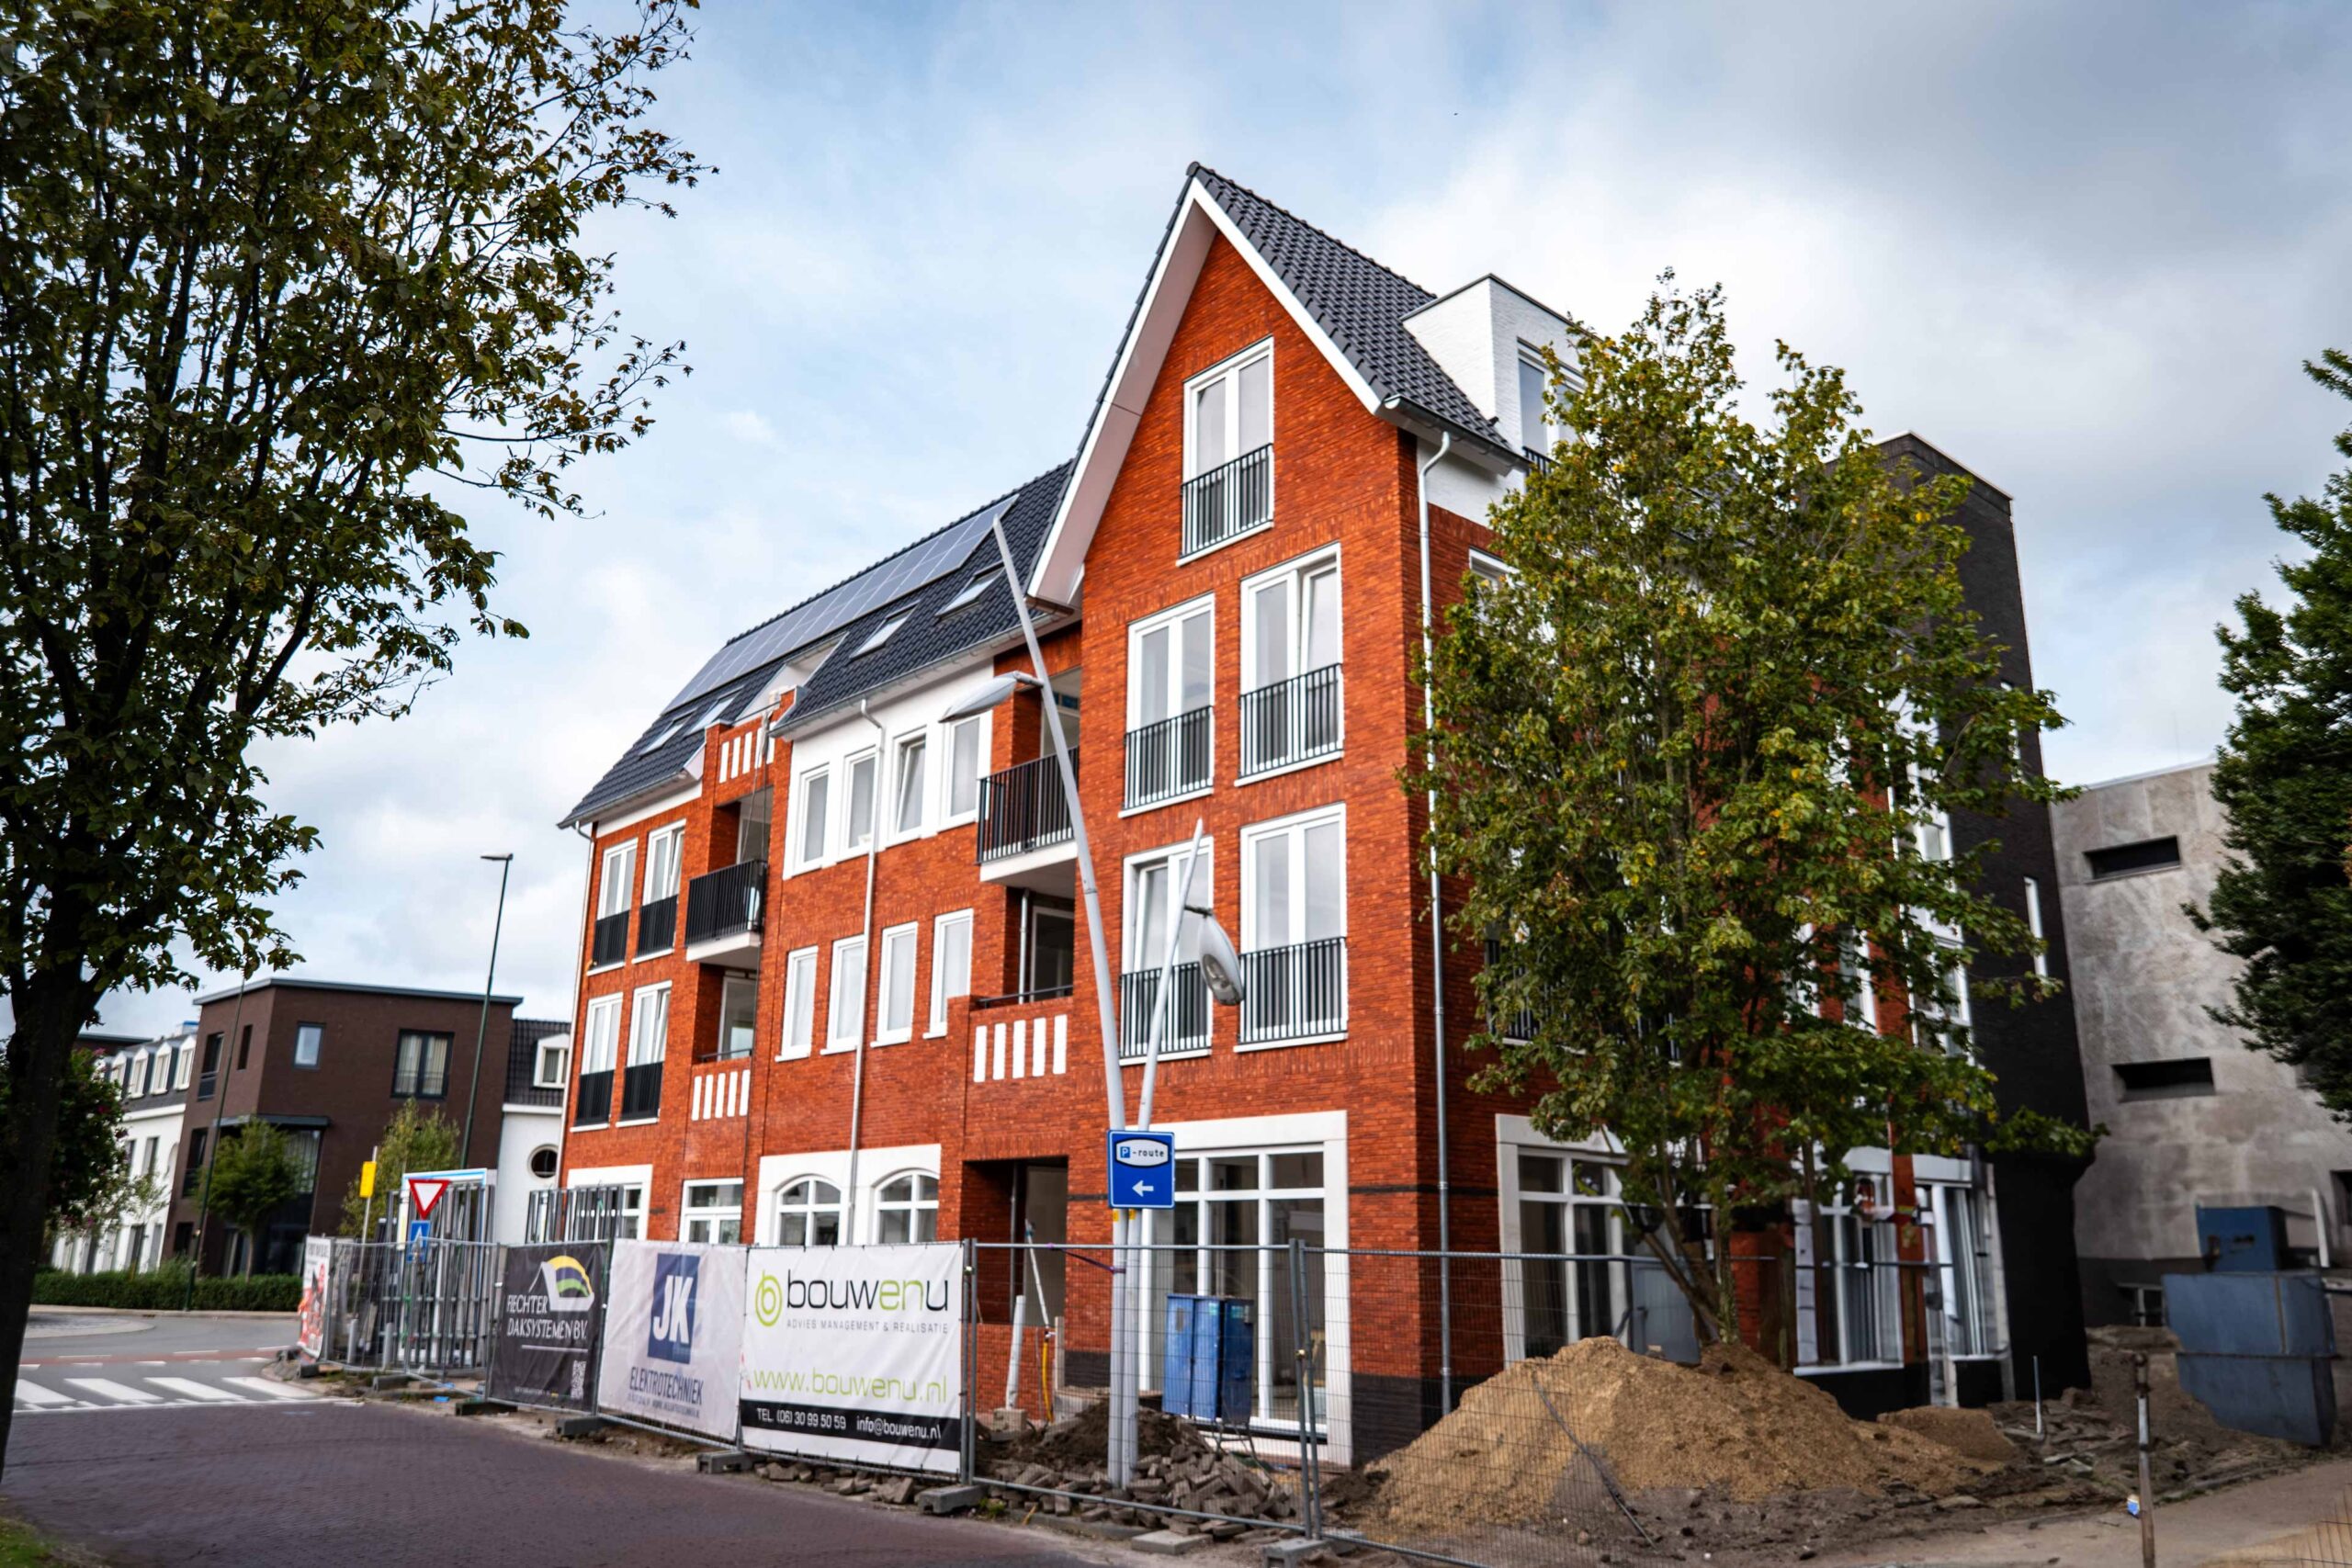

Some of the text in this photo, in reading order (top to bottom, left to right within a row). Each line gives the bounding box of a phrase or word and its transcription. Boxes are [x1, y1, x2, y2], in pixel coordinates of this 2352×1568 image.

[786, 1269, 948, 1312] bouwenu
[653, 1275, 694, 1344] JK
[787, 1318, 948, 1334] ADVIES MANAGEMENT & REALISATIE
[507, 1317, 572, 1339] DAKSYSTEMEN
[629, 1366, 704, 1405] ELEKTROTECHNIEK
[753, 1367, 947, 1403] www.bouwenu.nl
[776, 1409, 793, 1424] (06)
[794, 1411, 806, 1427] 30
[807, 1412, 819, 1427] 99
[820, 1414, 832, 1428] 50
[833, 1415, 846, 1430] 59
[856, 1416, 942, 1439] info@bouwenu.nl
